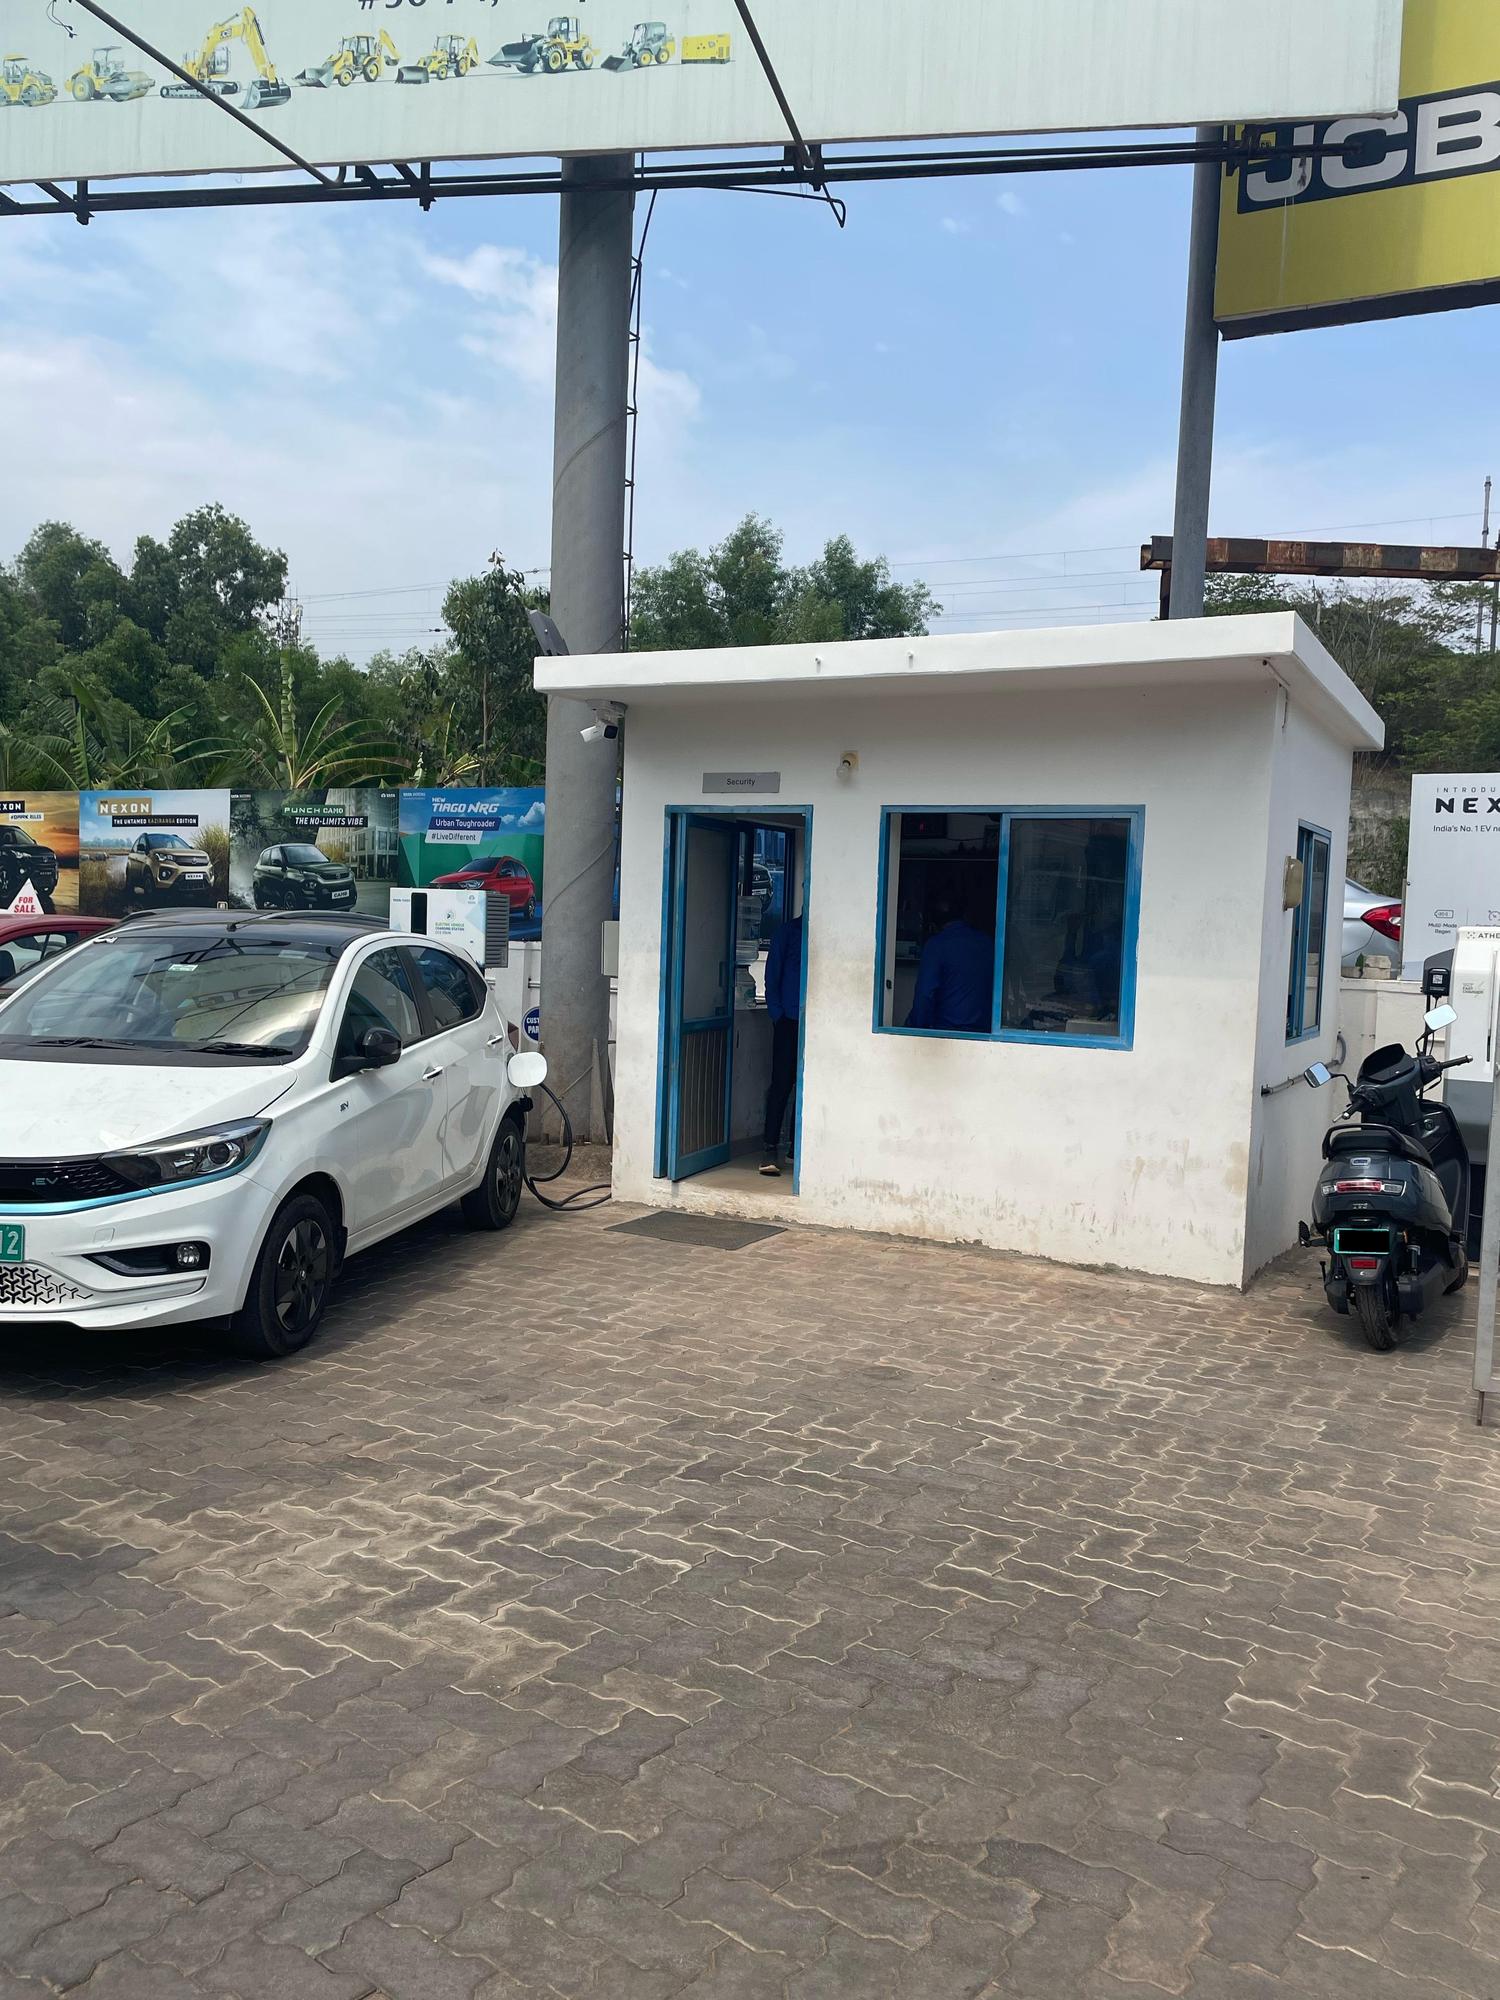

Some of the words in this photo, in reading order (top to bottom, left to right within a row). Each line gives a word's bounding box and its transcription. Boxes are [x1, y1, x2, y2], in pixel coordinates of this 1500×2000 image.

[1246, 92, 1500, 202] JCB
[726, 778, 756, 786] Security
[99, 803, 150, 814] NEXON
[432, 803, 467, 813] TIAGO
[467, 801, 500, 815] NRG
[1435, 797, 1500, 814] NEX
[295, 816, 308, 825] THE
[309, 817, 346, 826] NO-LIMITS
[347, 817, 364, 826] VIBE
[435, 819, 455, 827] Urban
[456, 819, 496, 828] Toughroader
[431, 832, 476, 841] #LiveDifferent
[18, 896, 33, 904] FOR
[14, 904, 36, 913] SALE
